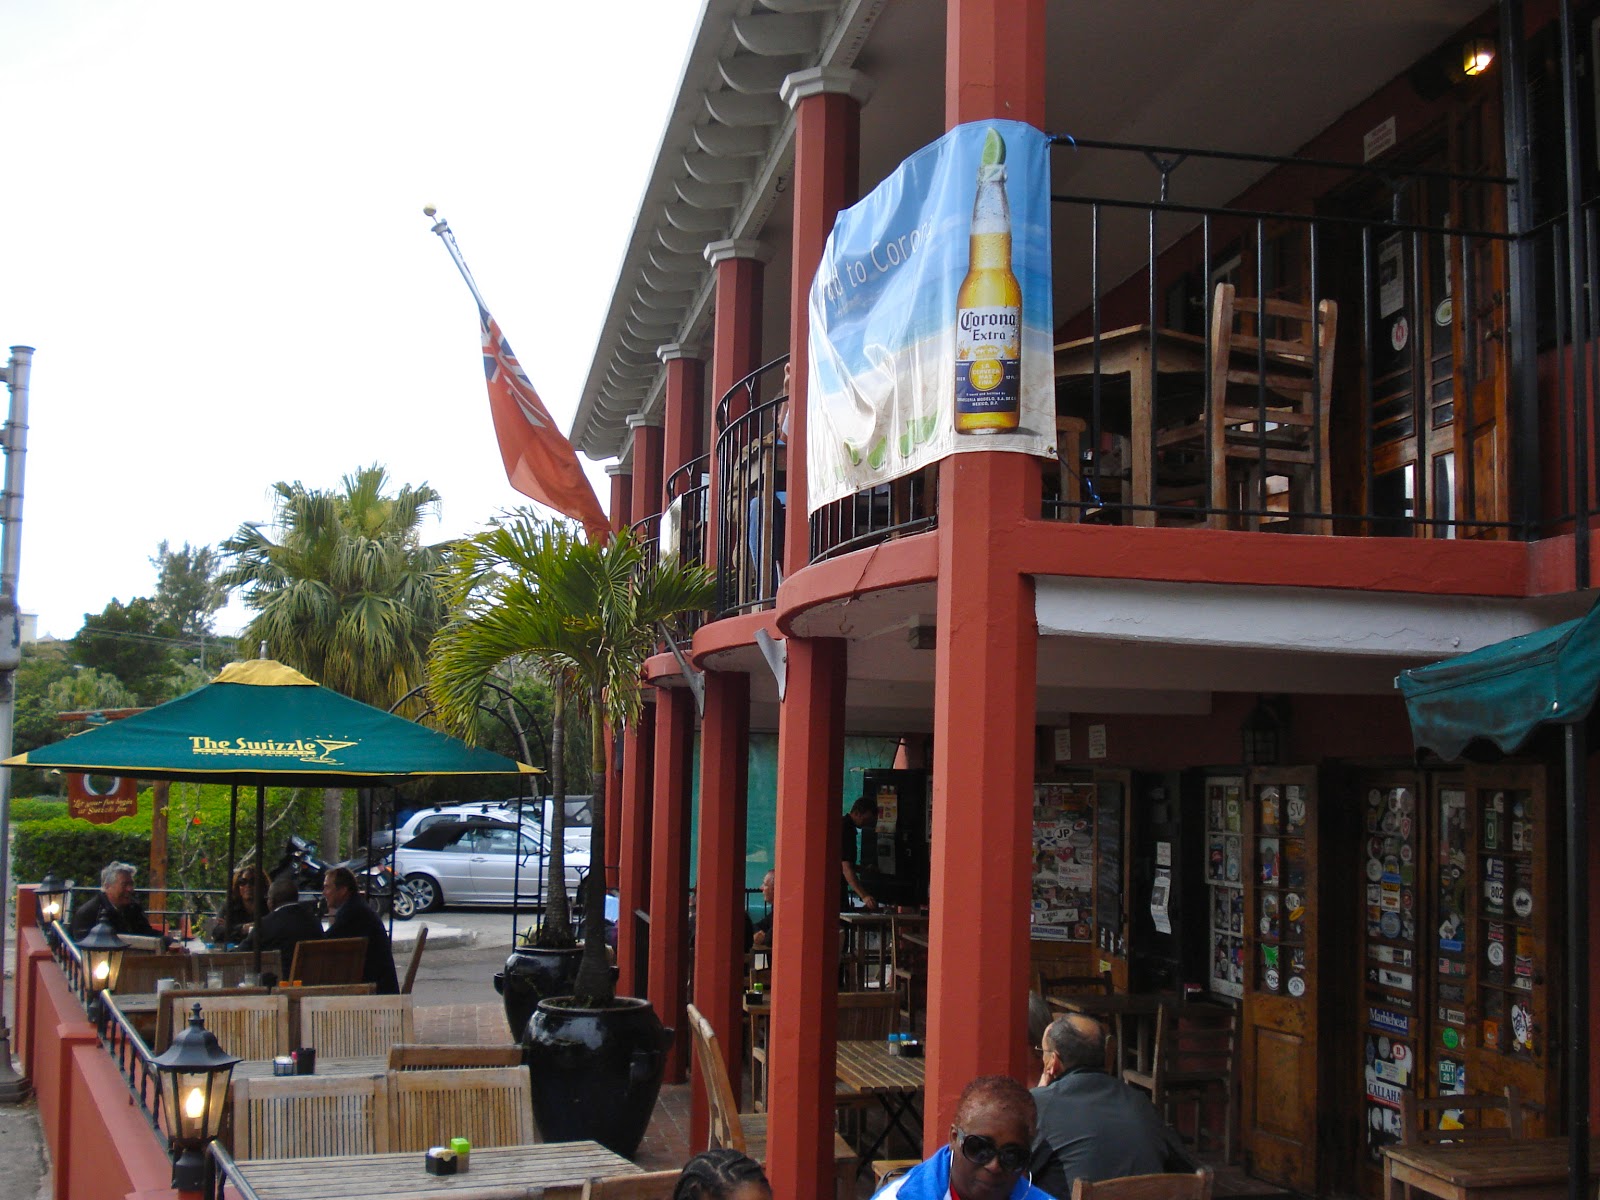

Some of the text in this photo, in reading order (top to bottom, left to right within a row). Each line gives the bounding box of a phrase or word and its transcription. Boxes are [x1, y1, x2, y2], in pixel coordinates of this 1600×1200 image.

[846, 260, 867, 288] to
[960, 311, 1016, 332] Corona
[972, 329, 1006, 341] Extra
[188, 736, 316, 752] The Swizzle
[1290, 802, 1303, 817] SV
[1056, 828, 1071, 840] JP
[1490, 885, 1504, 899] 802
[1369, 1007, 1408, 1030] Marblehead
[1440, 1063, 1455, 1073] EXIT
